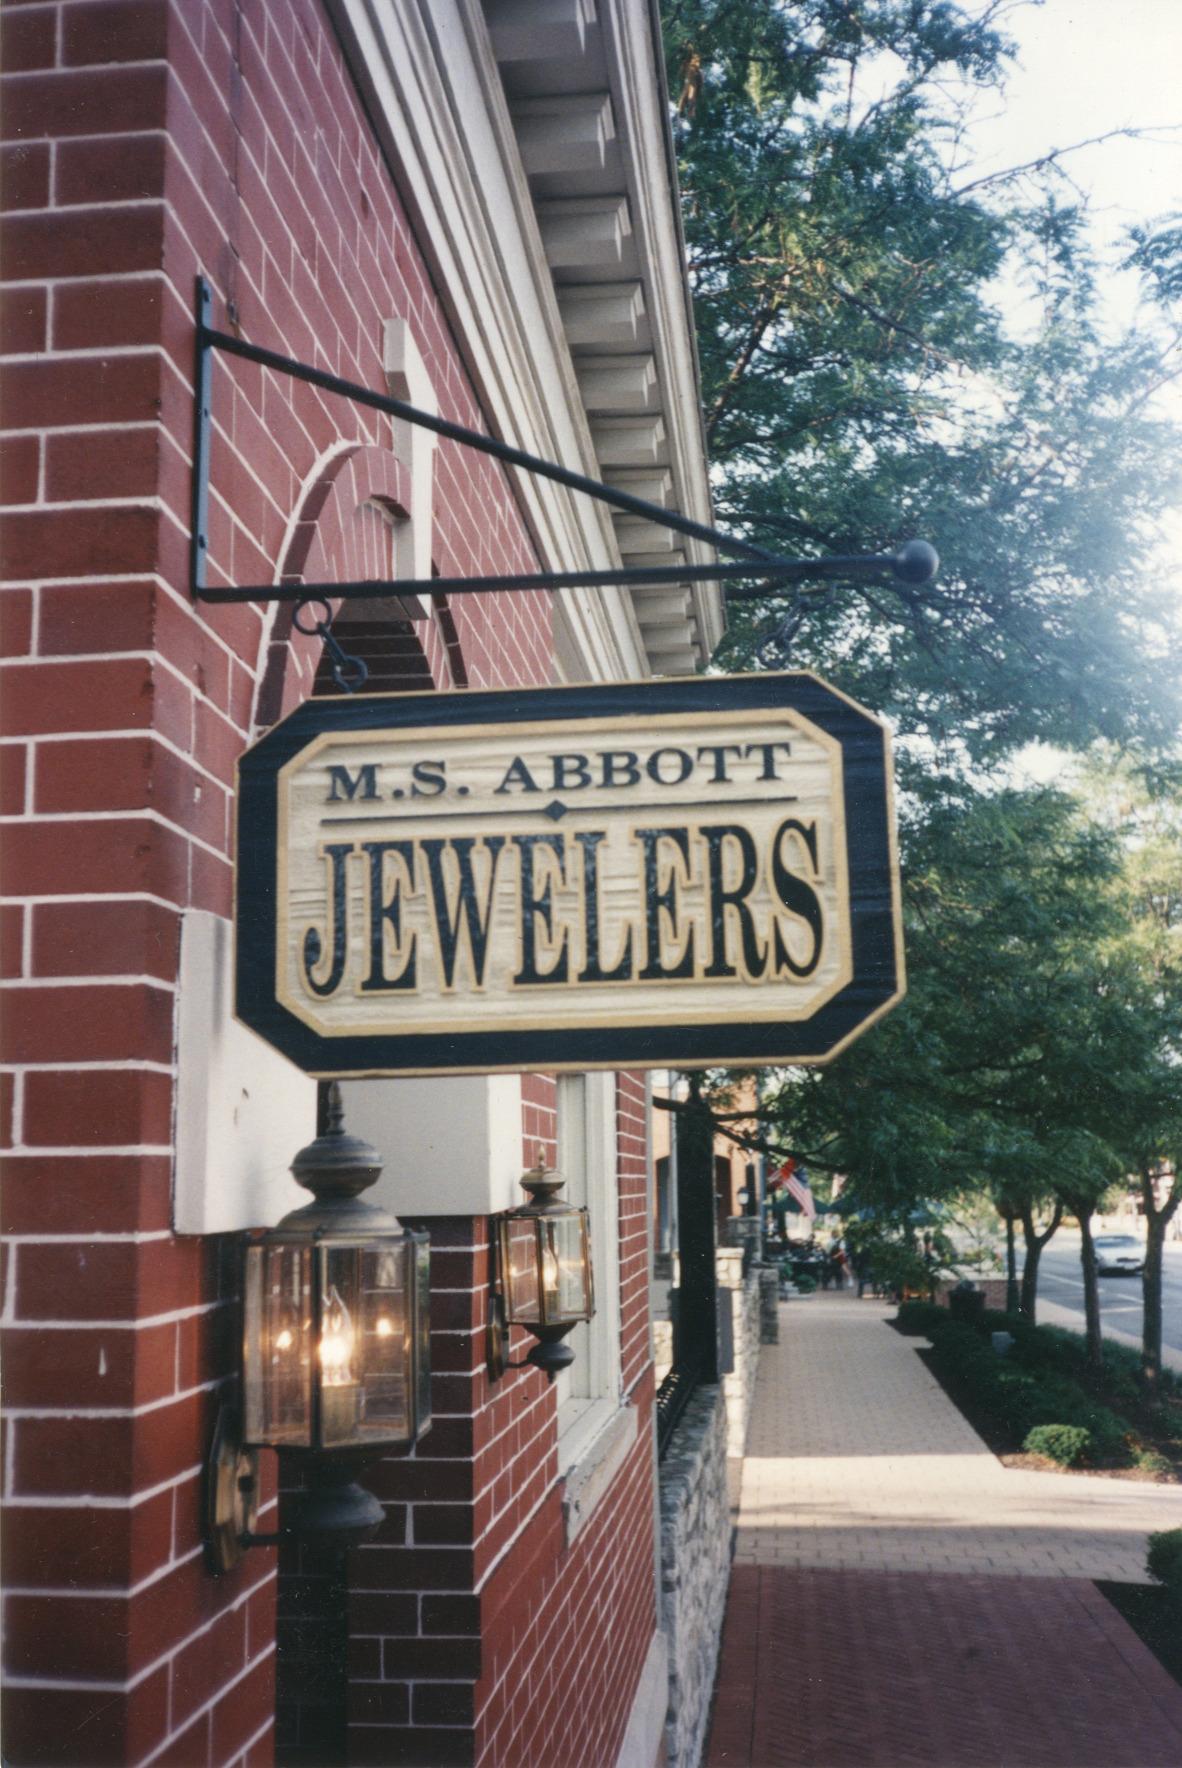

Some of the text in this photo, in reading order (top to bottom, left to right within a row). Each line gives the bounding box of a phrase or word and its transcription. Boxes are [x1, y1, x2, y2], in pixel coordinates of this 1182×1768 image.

[325, 742, 792, 801] M.S. ABBOTT
[302, 818, 826, 997] JEWELERS
